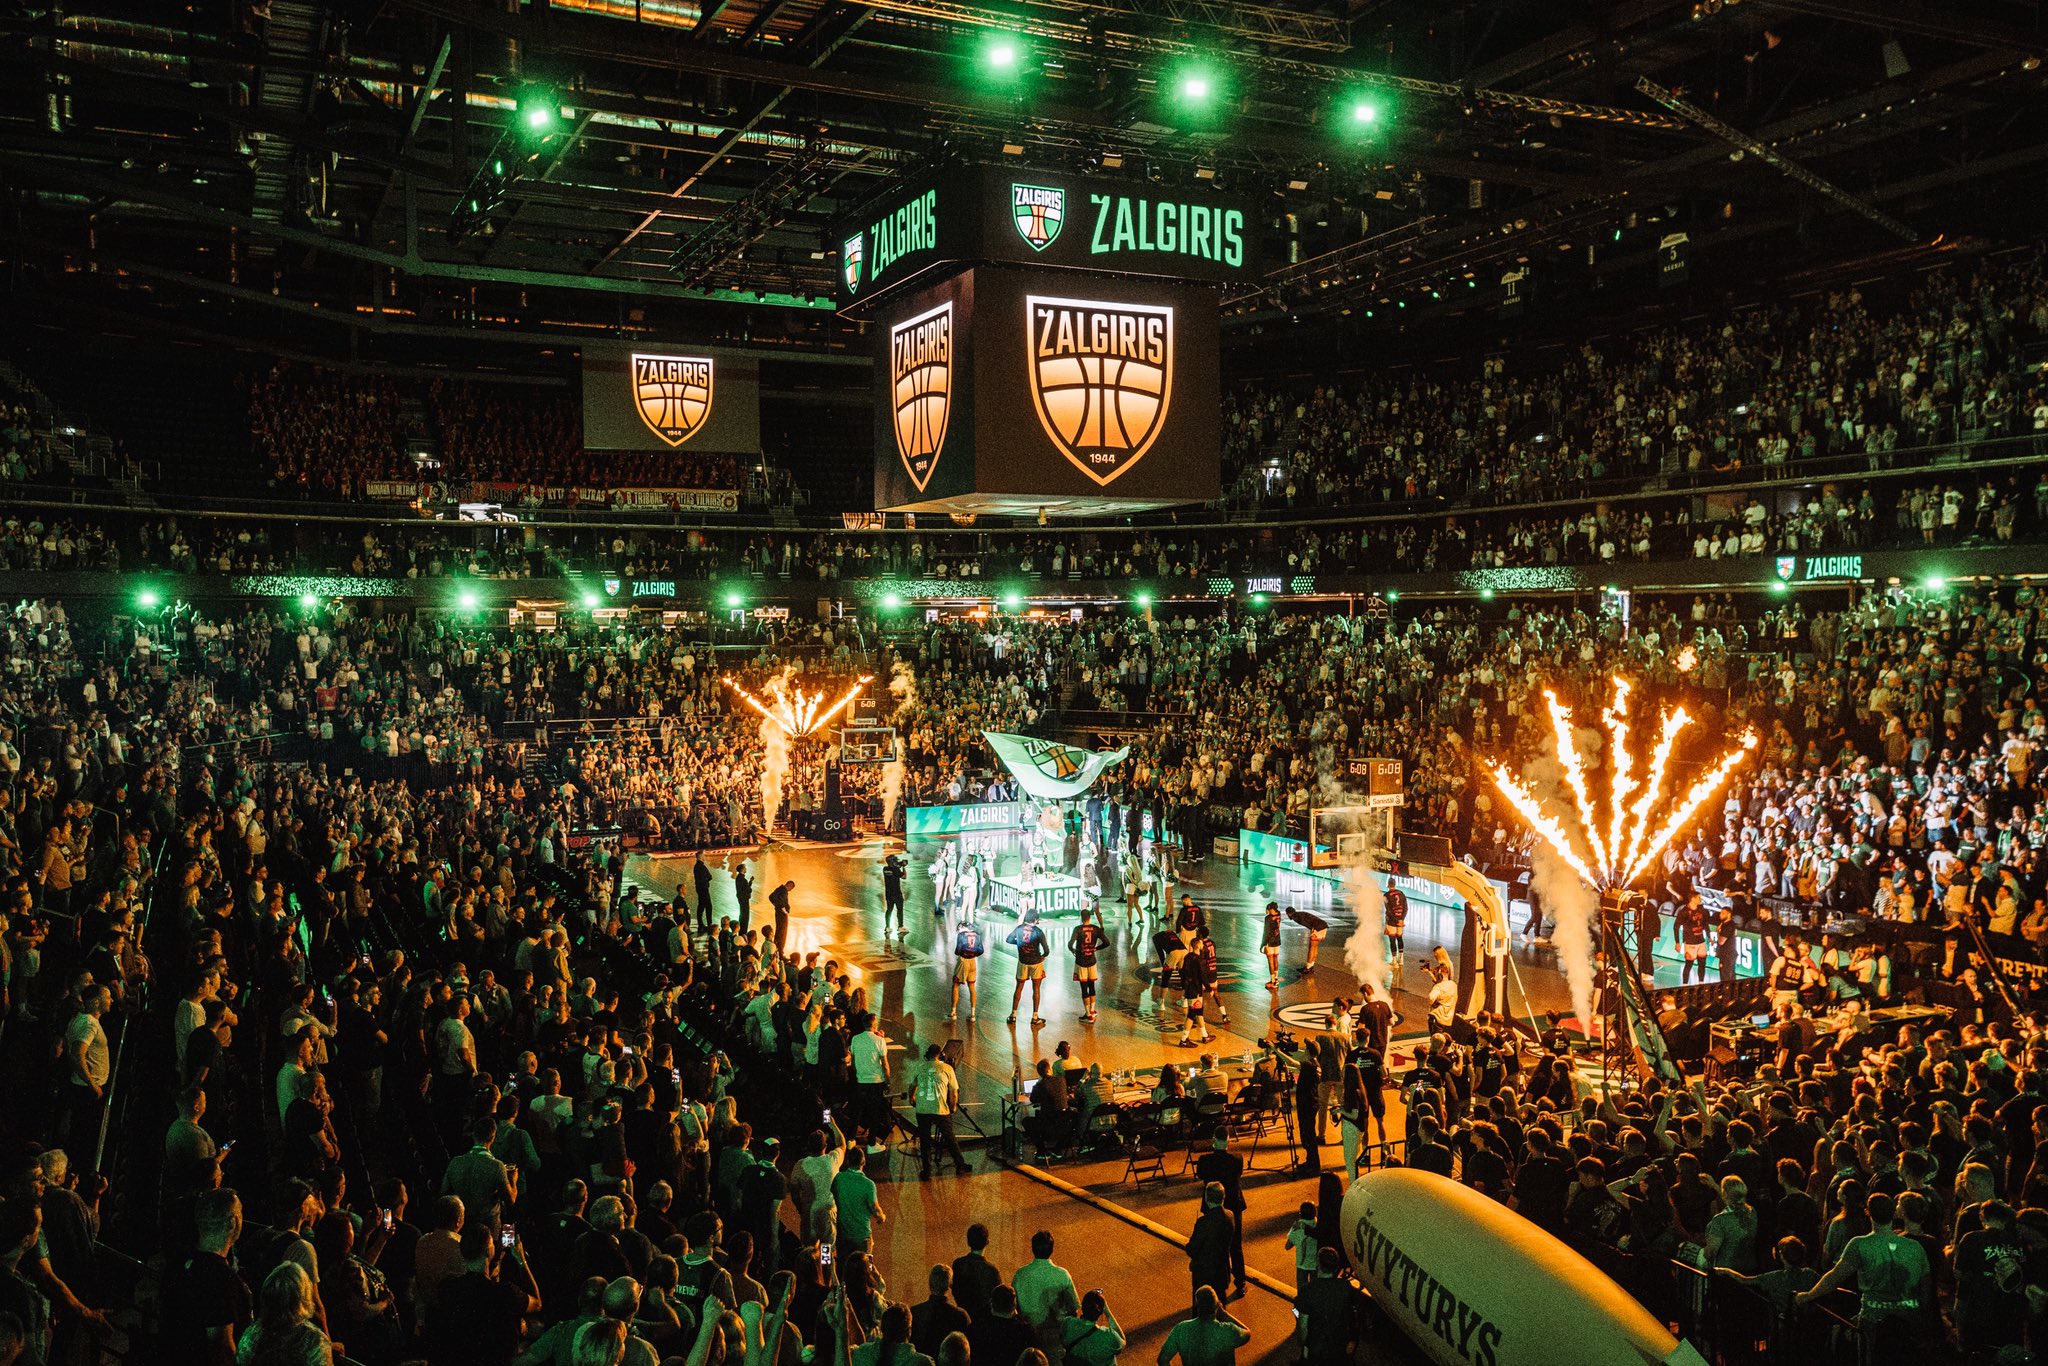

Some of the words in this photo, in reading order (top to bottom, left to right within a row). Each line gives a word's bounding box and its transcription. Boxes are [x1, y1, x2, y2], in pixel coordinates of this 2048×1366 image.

[1089, 453, 1116, 464] 1944
[1350, 762, 1367, 775] 6:08
[1377, 762, 1401, 775] 6:08
[1354, 1207, 1503, 1366] ŠVYTURYS
